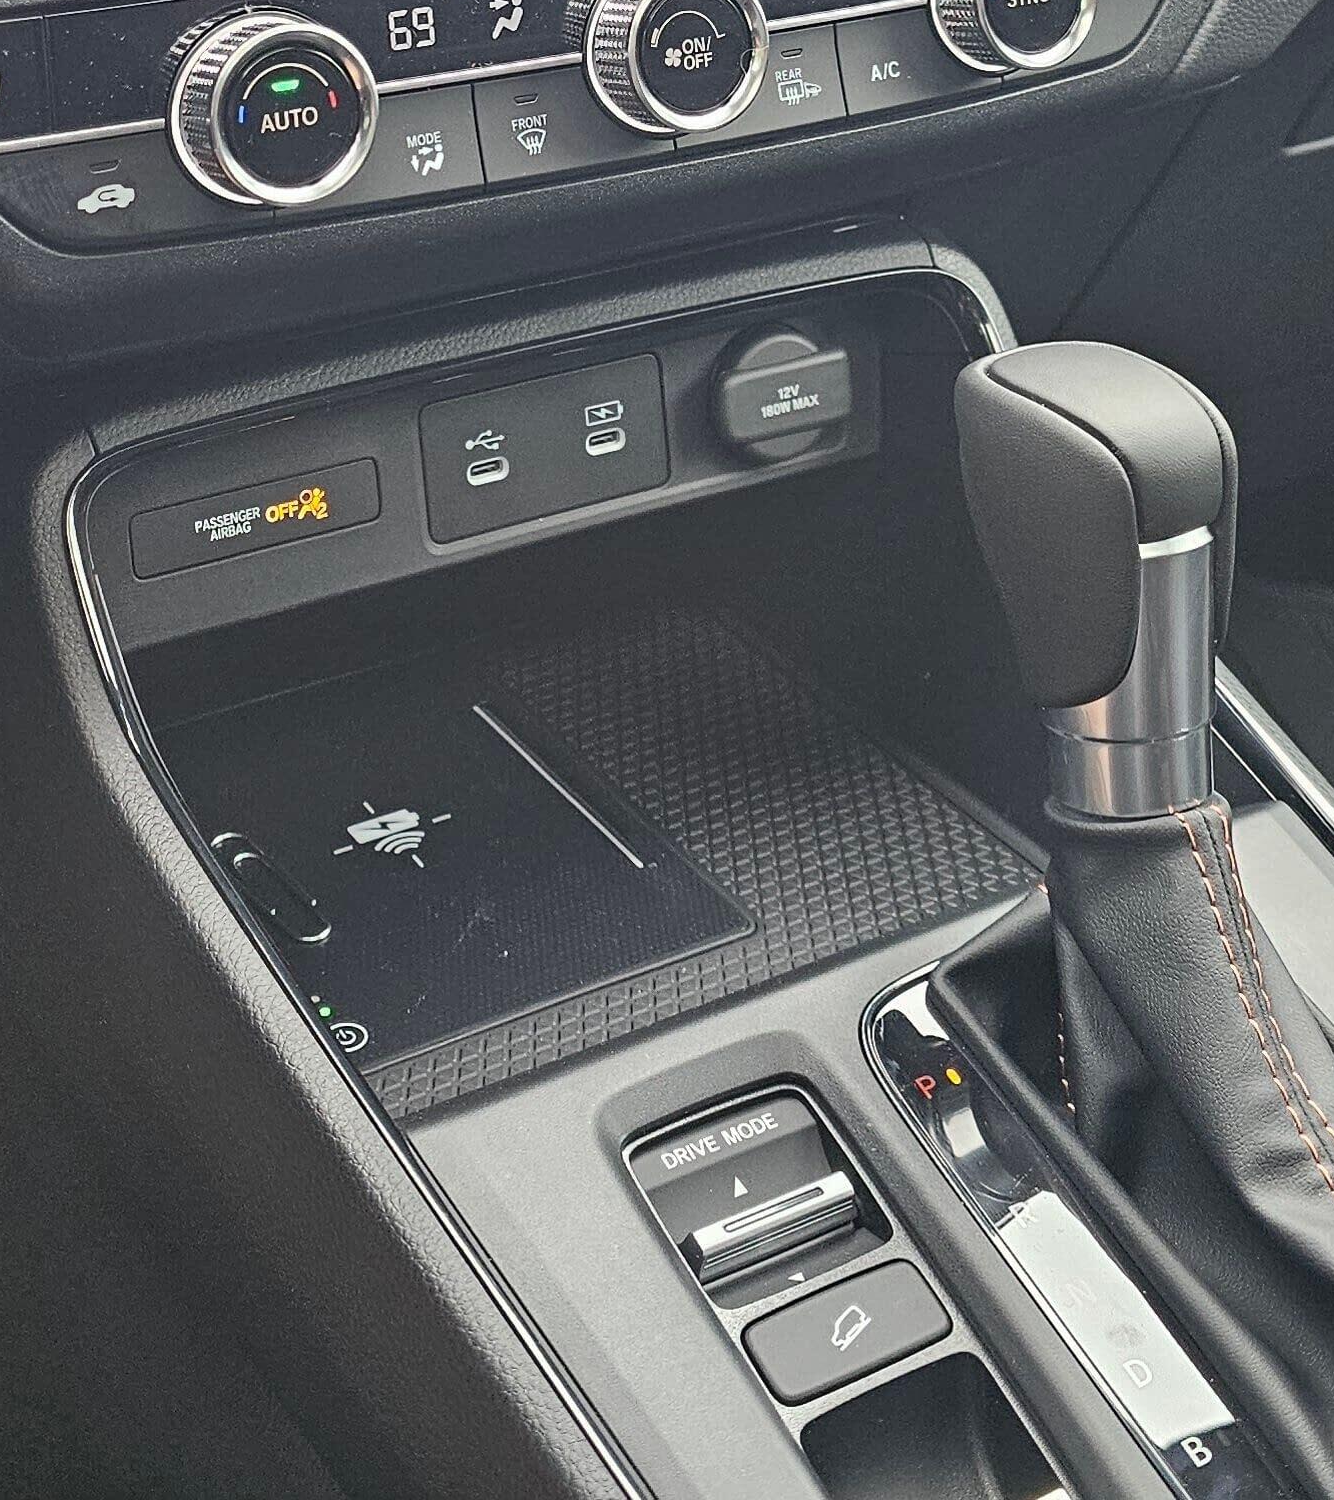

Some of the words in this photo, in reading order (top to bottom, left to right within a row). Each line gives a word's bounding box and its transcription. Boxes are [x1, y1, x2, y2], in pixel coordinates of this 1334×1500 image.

[387, 6, 438, 52] 69
[680, 35, 713, 57] ON/
[682, 51, 714, 72] OFF
[870, 61, 901, 83] A/C
[774, 67, 803, 82] REAR
[259, 105, 320, 134] AUTO
[511, 113, 549, 133] FRONT
[406, 130, 443, 150] MODE
[777, 383, 800, 401] 12V
[760, 400, 792, 419] 180W
[791, 393, 820, 411] MAX
[194, 506, 261, 534] PASSENGER
[264, 499, 299, 524] OFF
[209, 521, 252, 542] AIRBAG
[913, 1074, 938, 1100] P
[660, 1134, 721, 1171] DRIVE
[720, 1111, 779, 1147] MODE
[1121, 1358, 1155, 1390] D
[1179, 1435, 1213, 1469] B
